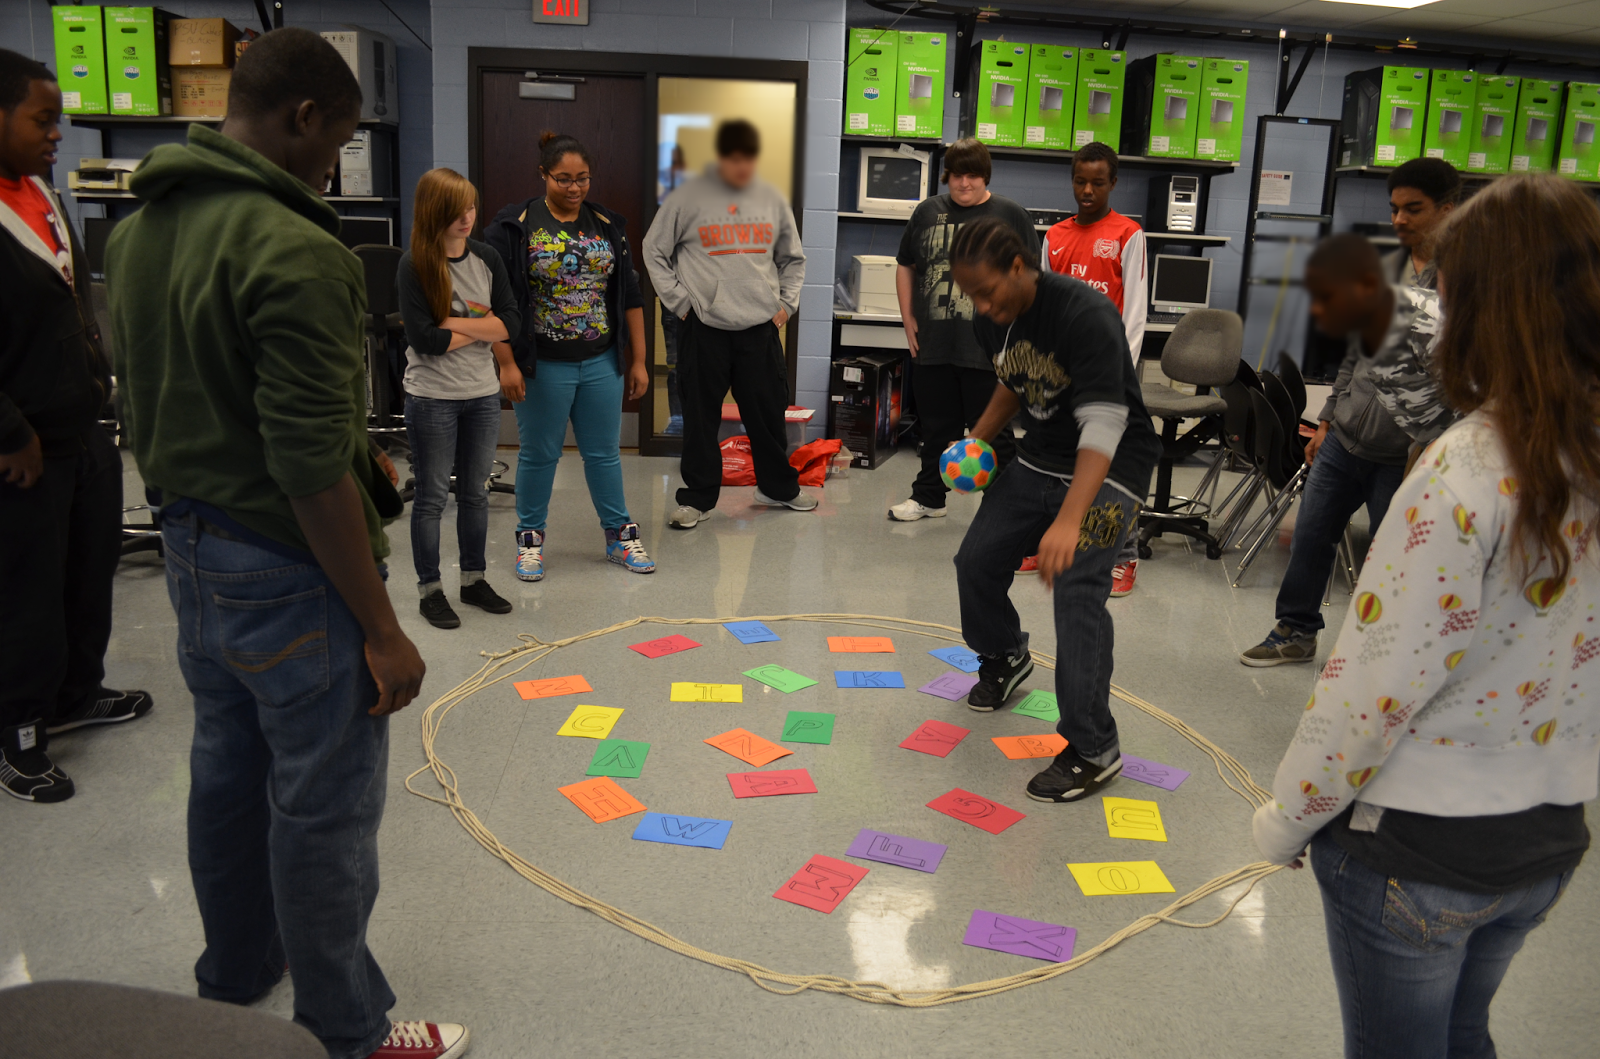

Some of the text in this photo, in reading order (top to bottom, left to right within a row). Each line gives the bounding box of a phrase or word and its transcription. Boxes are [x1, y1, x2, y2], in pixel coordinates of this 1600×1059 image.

[174, 22, 198, 36] PSU
[937, 213, 948, 223] THE
[698, 223, 774, 248] BROWNS
[1071, 264, 1087, 277] Fly
[732, 624, 773, 638] E
[648, 640, 679, 654] S
[853, 672, 886, 686] K
[928, 677, 961, 694] L
[694, 684, 723, 702] I
[1020, 694, 1059, 712] D
[571, 712, 612, 732] C
[785, 720, 824, 736] P
[914, 726, 959, 745] Y
[1017, 738, 1054, 756] B
[1122, 761, 1169, 784] R
[744, 774, 798, 794] A
[570, 784, 632, 819] H
[660, 816, 720, 840] W
[866, 834, 926, 868] F
[788, 864, 854, 902] M
[988, 916, 1067, 958] X
